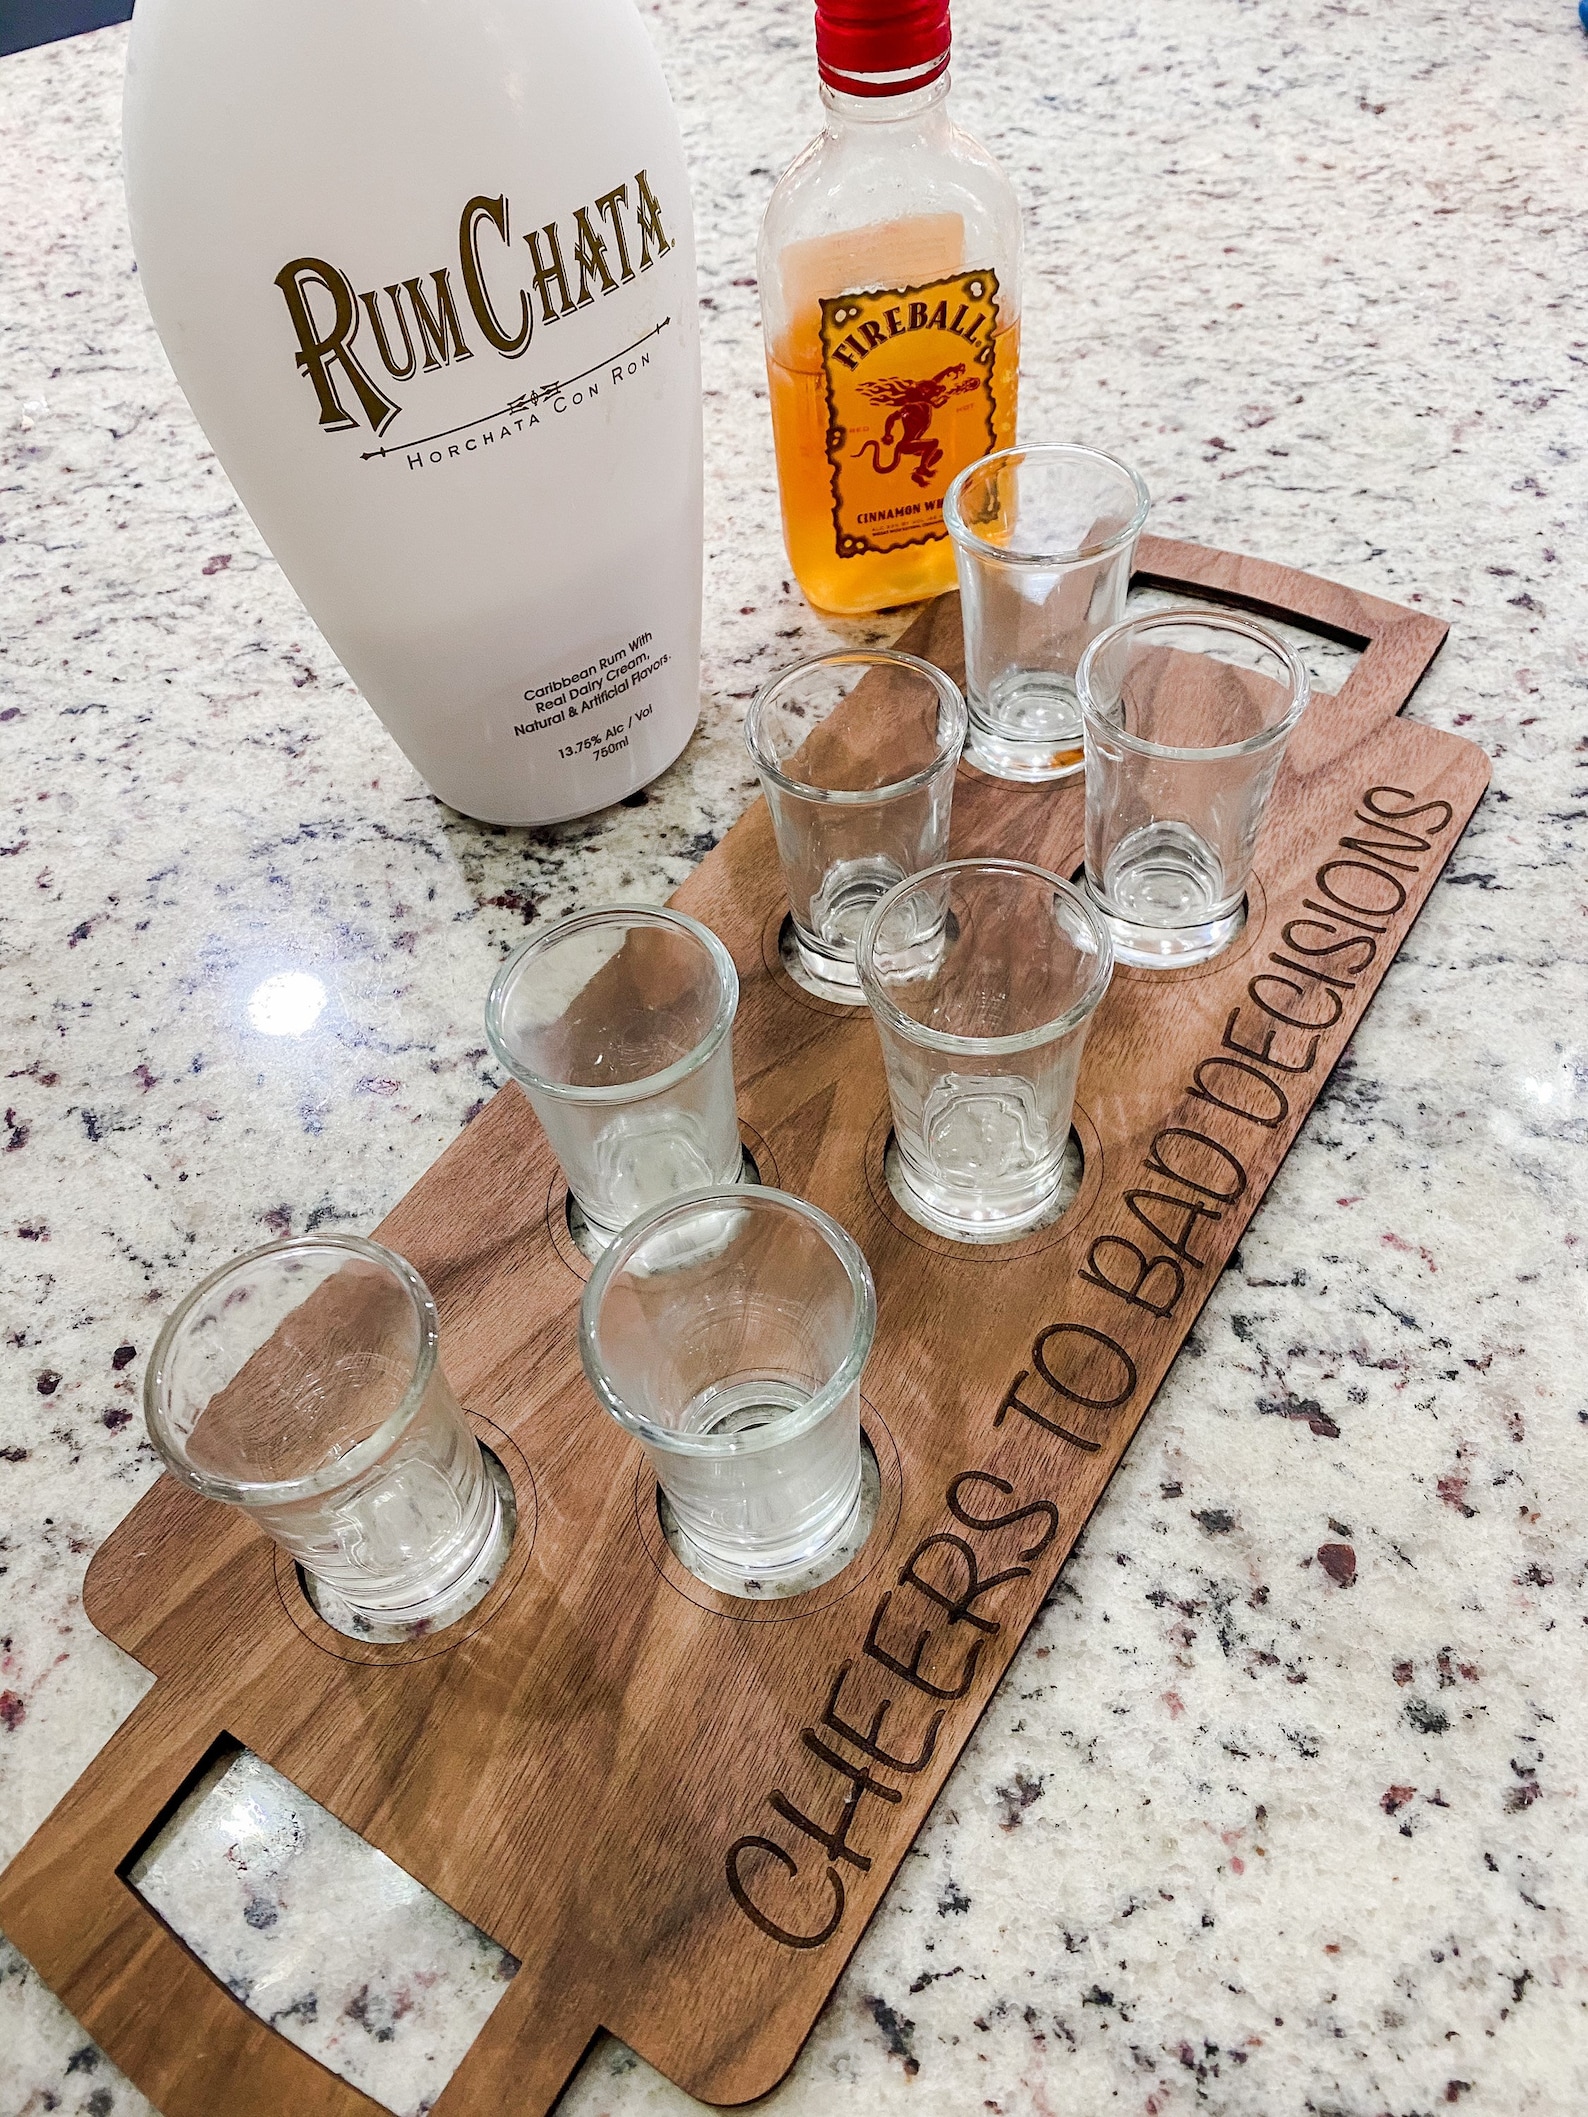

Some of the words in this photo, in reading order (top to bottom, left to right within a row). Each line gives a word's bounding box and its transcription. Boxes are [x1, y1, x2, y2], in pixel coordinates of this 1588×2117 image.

[857, 503, 921, 524] CINNAMON
[513, 710, 565, 737] Natural
[568, 706, 579, 718] &
[581, 679, 630, 713] Artificial
[631, 653, 672, 686] Flavors.
[523, 665, 597, 701] Caribbean
[599, 649, 627, 670] Rum
[628, 631, 653, 652] With
[535, 693, 567, 713] Real
[569, 678, 604, 700] Dairy
[606, 652, 650, 681] Cream,
[558, 734, 602, 759] 13.75%
[605, 723, 625, 740] Alc
[628, 716, 632, 729] /
[634, 703, 653, 722] Vol
[592, 736, 630, 761] 750ml
[725, 1470, 1059, 1949] CHEERS
[993, 1322, 1137, 1452] TO
[1078, 1127, 1248, 1318] BAD
[1186, 785, 1454, 1130] DECISIONS
